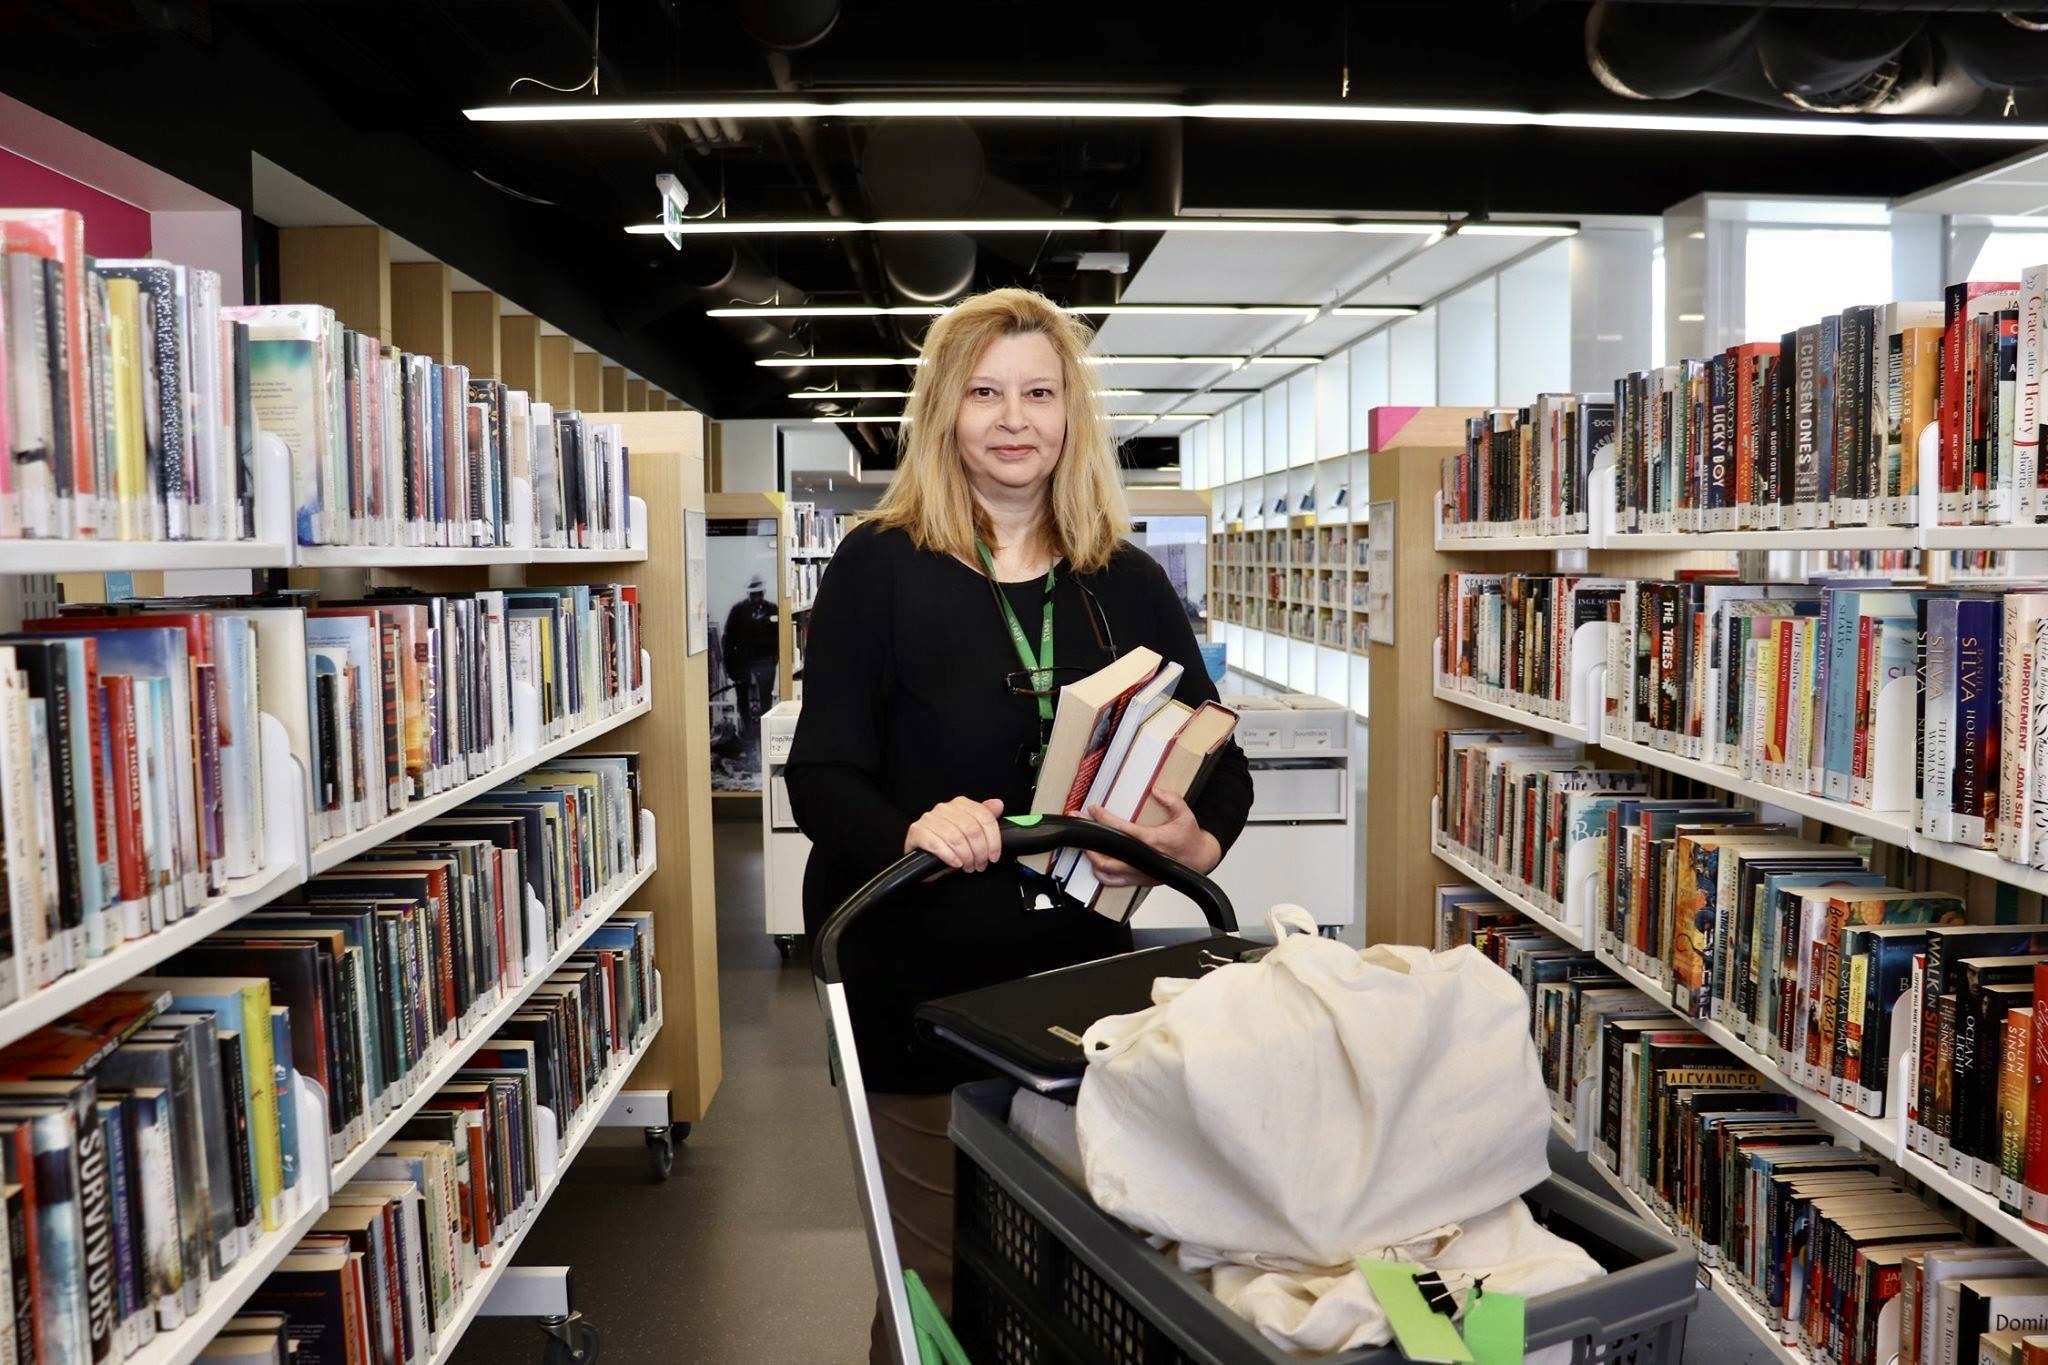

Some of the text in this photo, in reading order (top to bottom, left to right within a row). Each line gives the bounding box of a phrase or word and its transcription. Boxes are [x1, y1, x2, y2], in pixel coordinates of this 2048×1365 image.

[2027, 296, 2041, 347] Grace
[1726, 356, 1736, 440] SNAKEWOOD
[1799, 344, 1814, 464] CHOSEN ONES
[2025, 382, 2041, 435] Henry
[1712, 404, 1727, 452] LUCKY
[1712, 455, 1726, 488] BOY
[1769, 474, 1777, 500] BLOOD
[1662, 600, 1675, 623] THE
[1836, 604, 1846, 658] SHALVIS
[1661, 628, 1674, 670] TREES
[1781, 647, 1789, 682] SHALVIS
[1793, 631, 1801, 648] Jill
[1817, 631, 1826, 680] SHALVIS
[1858, 647, 1866, 672] Instant
[1917, 631, 1927, 694] SILVA
[1792, 650, 1801, 691] Shalvis
[1856, 673, 1865, 711] Temptation
[1928, 636, 1945, 701] SILVA
[1961, 637, 1978, 814] SILVA HOUSE OF SPIES
[2016, 653, 2031, 799] IMPROVEMENT JOAN
[59, 738, 73, 808] THOMAS
[126, 703, 140, 811] JODI THOMAS
[1927, 730, 1937, 784] WOMAN
[1936, 718, 1947, 798] THE OTHER
[1639, 829, 1647, 880] NETWORK
[1823, 905, 1844, 1035] Bone Meal Roses
[1840, 969, 1849, 1003] SAW
[1927, 936, 1942, 991] WALK
[1839, 1005, 1848, 1015] A
[1927, 993, 1938, 1008] IN
[1837, 1019, 1848, 1053] MAN
[1923, 1010, 1938, 1087] SILENCE
[1940, 1023, 1950, 1062] SINGH
[1954, 1034, 1965, 1077] LIGHT
[1964, 1015, 1976, 1068] OCEAN
[2006, 1025, 2017, 1073] SINGH
[2015, 1025, 2026, 1079] NALINI
[2002, 1110, 2012, 1177] OF SUNSHI
[2009, 1117, 2020, 1181] A MADNES
[79, 1128, 112, 1342] SURVIVORS
[1903, 1280, 1914, 1336] Ali Smith
